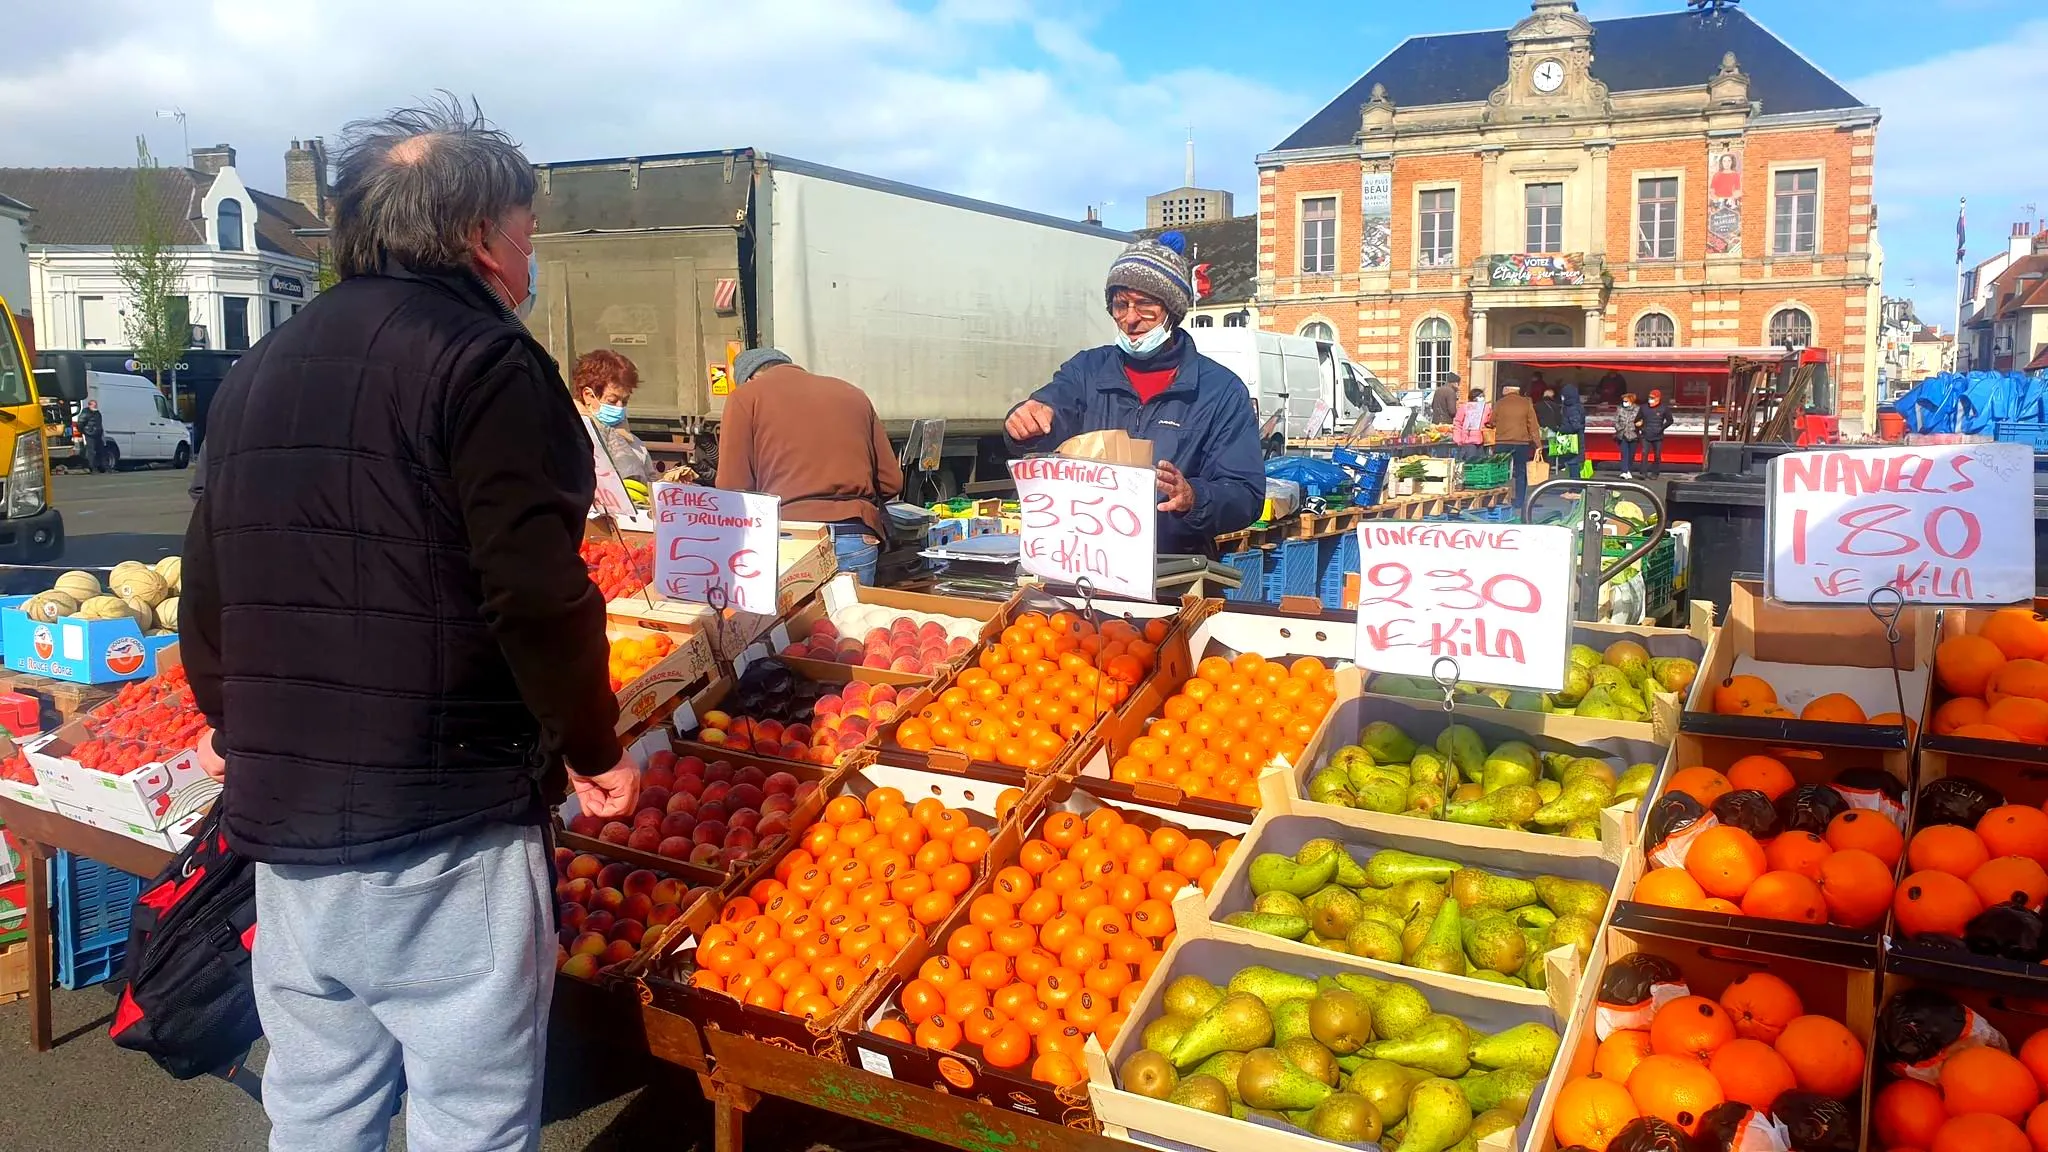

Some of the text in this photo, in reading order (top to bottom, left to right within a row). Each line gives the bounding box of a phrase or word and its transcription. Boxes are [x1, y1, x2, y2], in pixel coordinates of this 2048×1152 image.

[1364, 185, 1388, 194] BEAU
[1524, 259, 1550, 267] VOTEZ
[1783, 453, 1976, 497] NAVELS
[27, 657, 48, 671] ROUGE
[51, 661, 73, 675] GORGE
